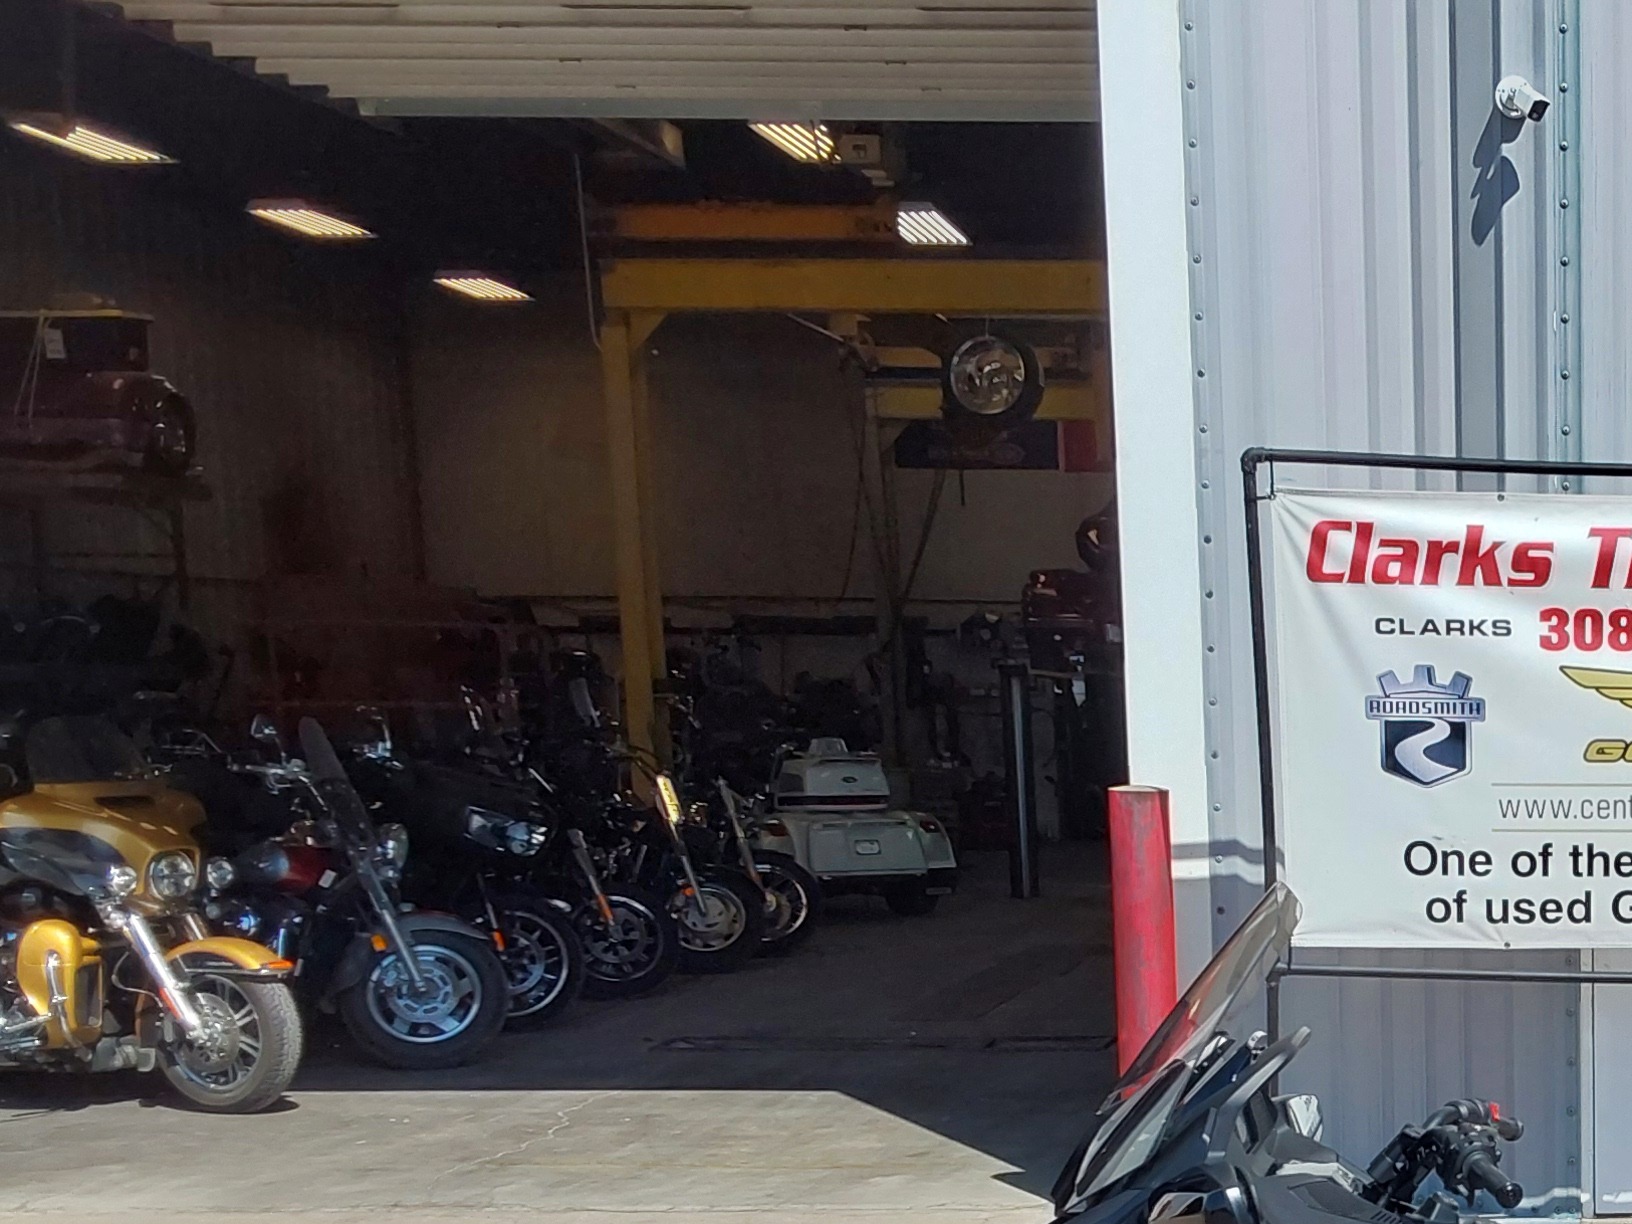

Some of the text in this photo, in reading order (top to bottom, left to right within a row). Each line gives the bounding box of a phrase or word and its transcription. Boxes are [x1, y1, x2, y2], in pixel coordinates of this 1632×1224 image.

[1306, 519, 1555, 588] Clarks
[1374, 617, 1512, 637] CLARKS
[1369, 699, 1482, 716] ROADSMITH
[1403, 840, 1494, 878] One
[1511, 842, 1553, 878] of
[1425, 889, 1468, 924] of
[1485, 890, 1593, 924] used
